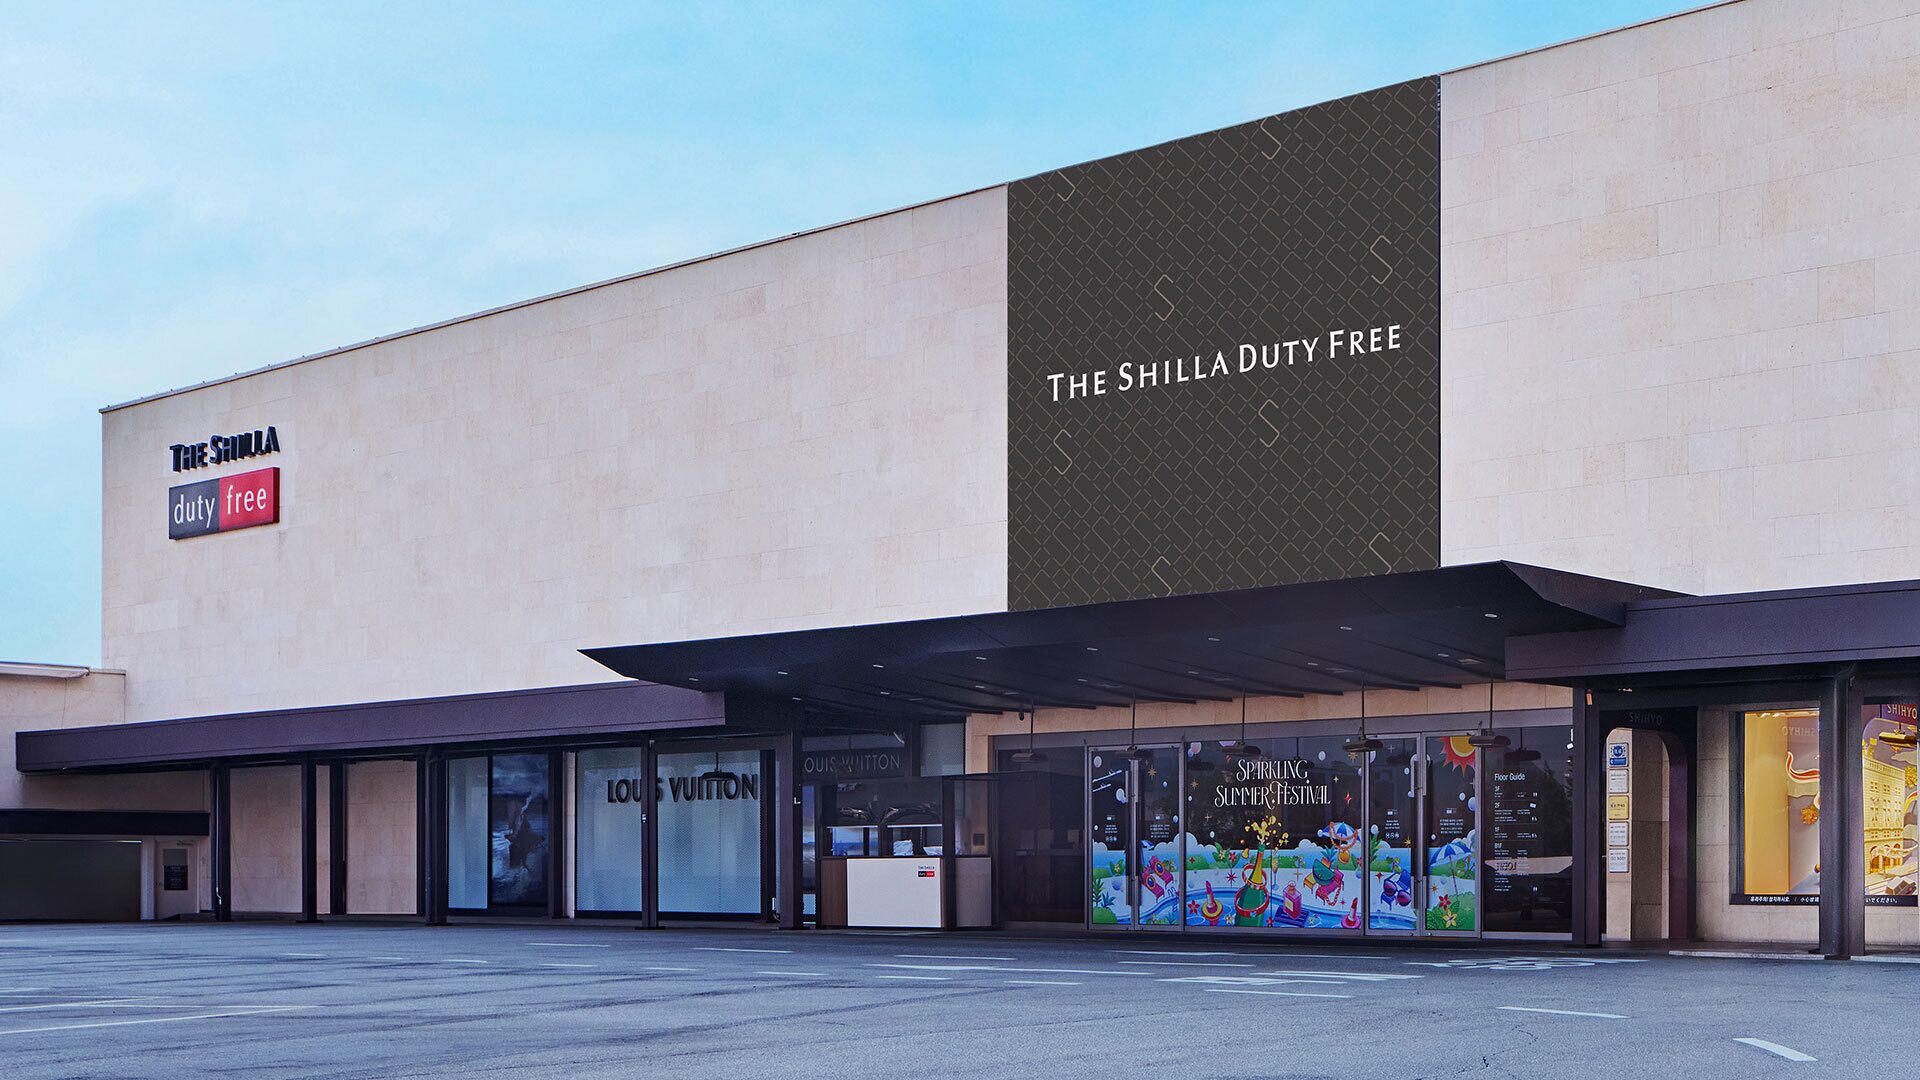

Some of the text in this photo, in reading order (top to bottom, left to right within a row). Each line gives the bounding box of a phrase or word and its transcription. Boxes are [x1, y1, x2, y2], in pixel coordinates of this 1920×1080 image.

[1047, 323, 1401, 402] THE SHILLA DUTY FREE
[169, 425, 281, 473] THE SHILLA
[174, 484, 267, 529] duty free
[1886, 703, 1918, 720] SHIHYO
[1236, 759, 1309, 782] SPARKLING
[1494, 772, 1526, 781] Floor Guide
[607, 773, 758, 803] LOUS VUITTON
[1214, 780, 1332, 810] SUMMER FESTIVAL
